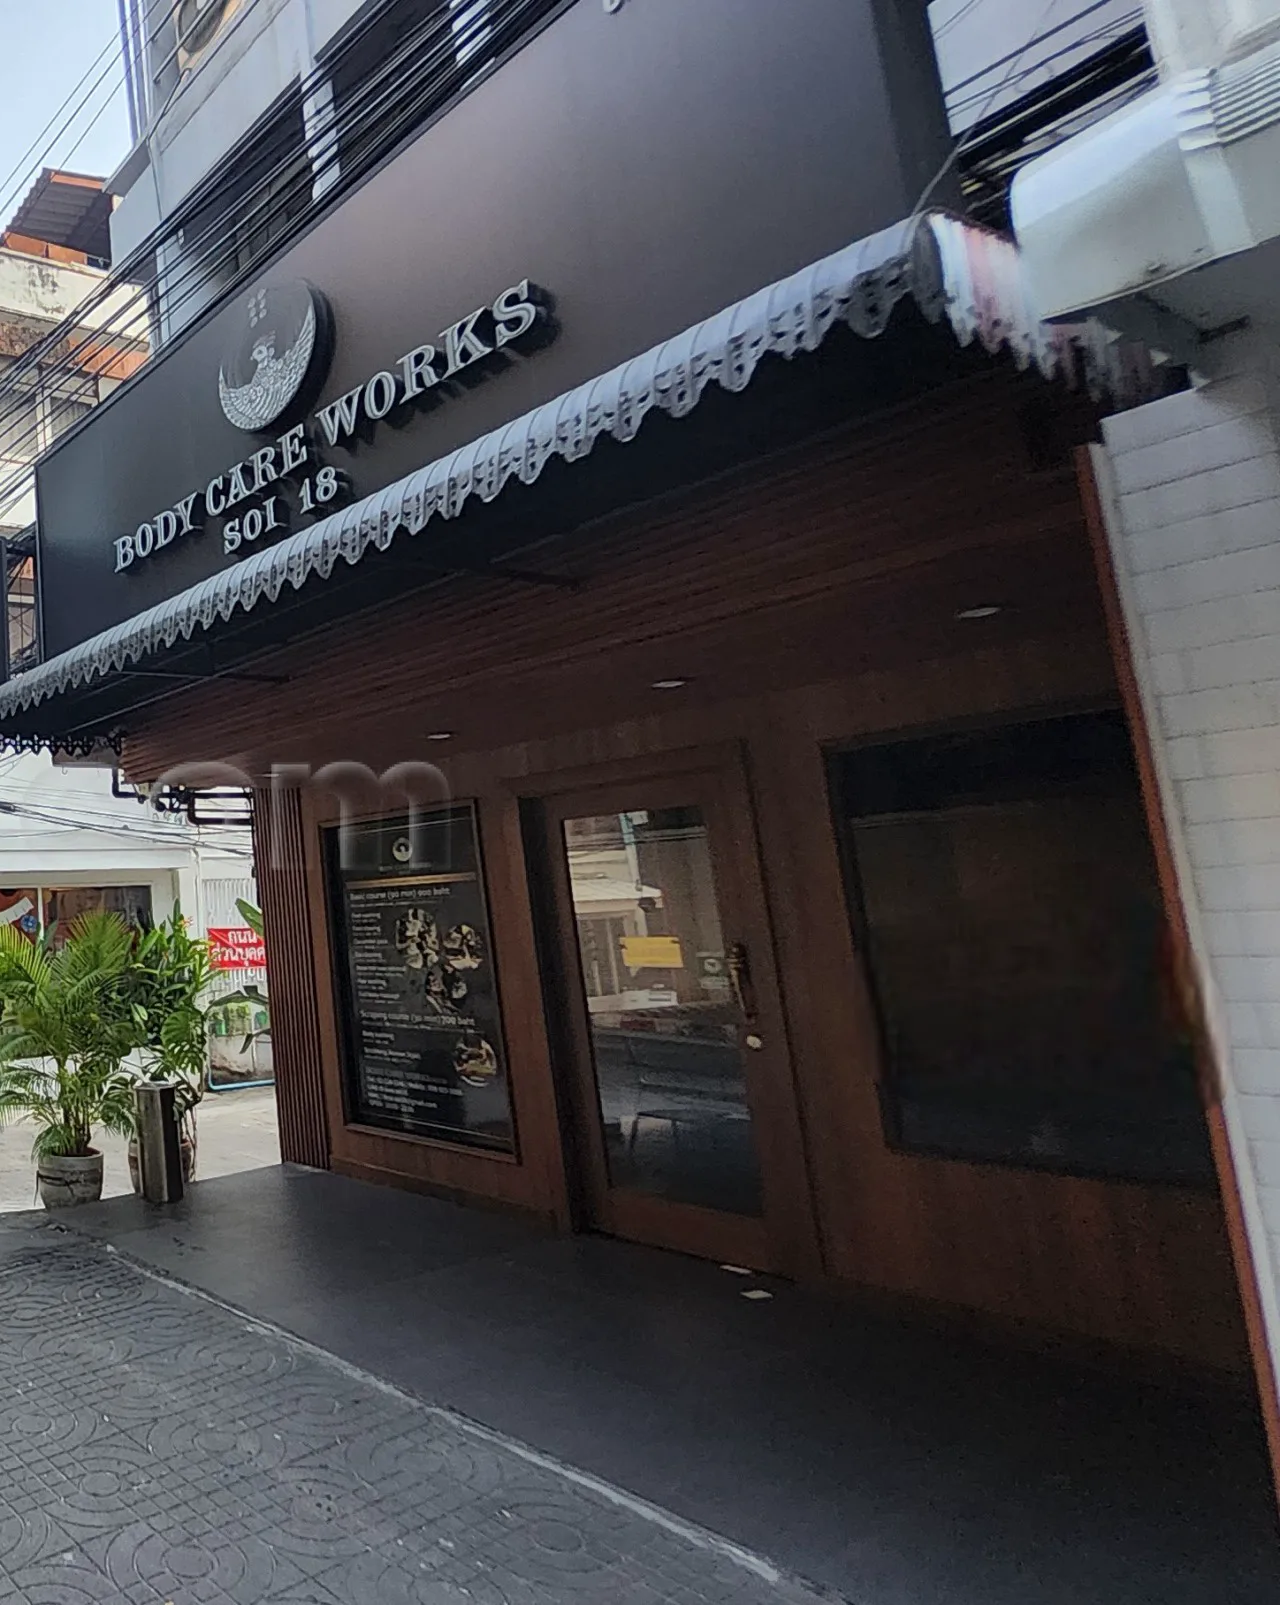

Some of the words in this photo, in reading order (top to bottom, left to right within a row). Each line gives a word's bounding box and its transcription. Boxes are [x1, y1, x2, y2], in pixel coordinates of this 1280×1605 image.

[113, 491, 198, 573] BODY
[205, 423, 308, 516] CARE
[315, 278, 537, 447] WORKS
[223, 495, 280, 555] SOI
[298, 466, 338, 514] 18
